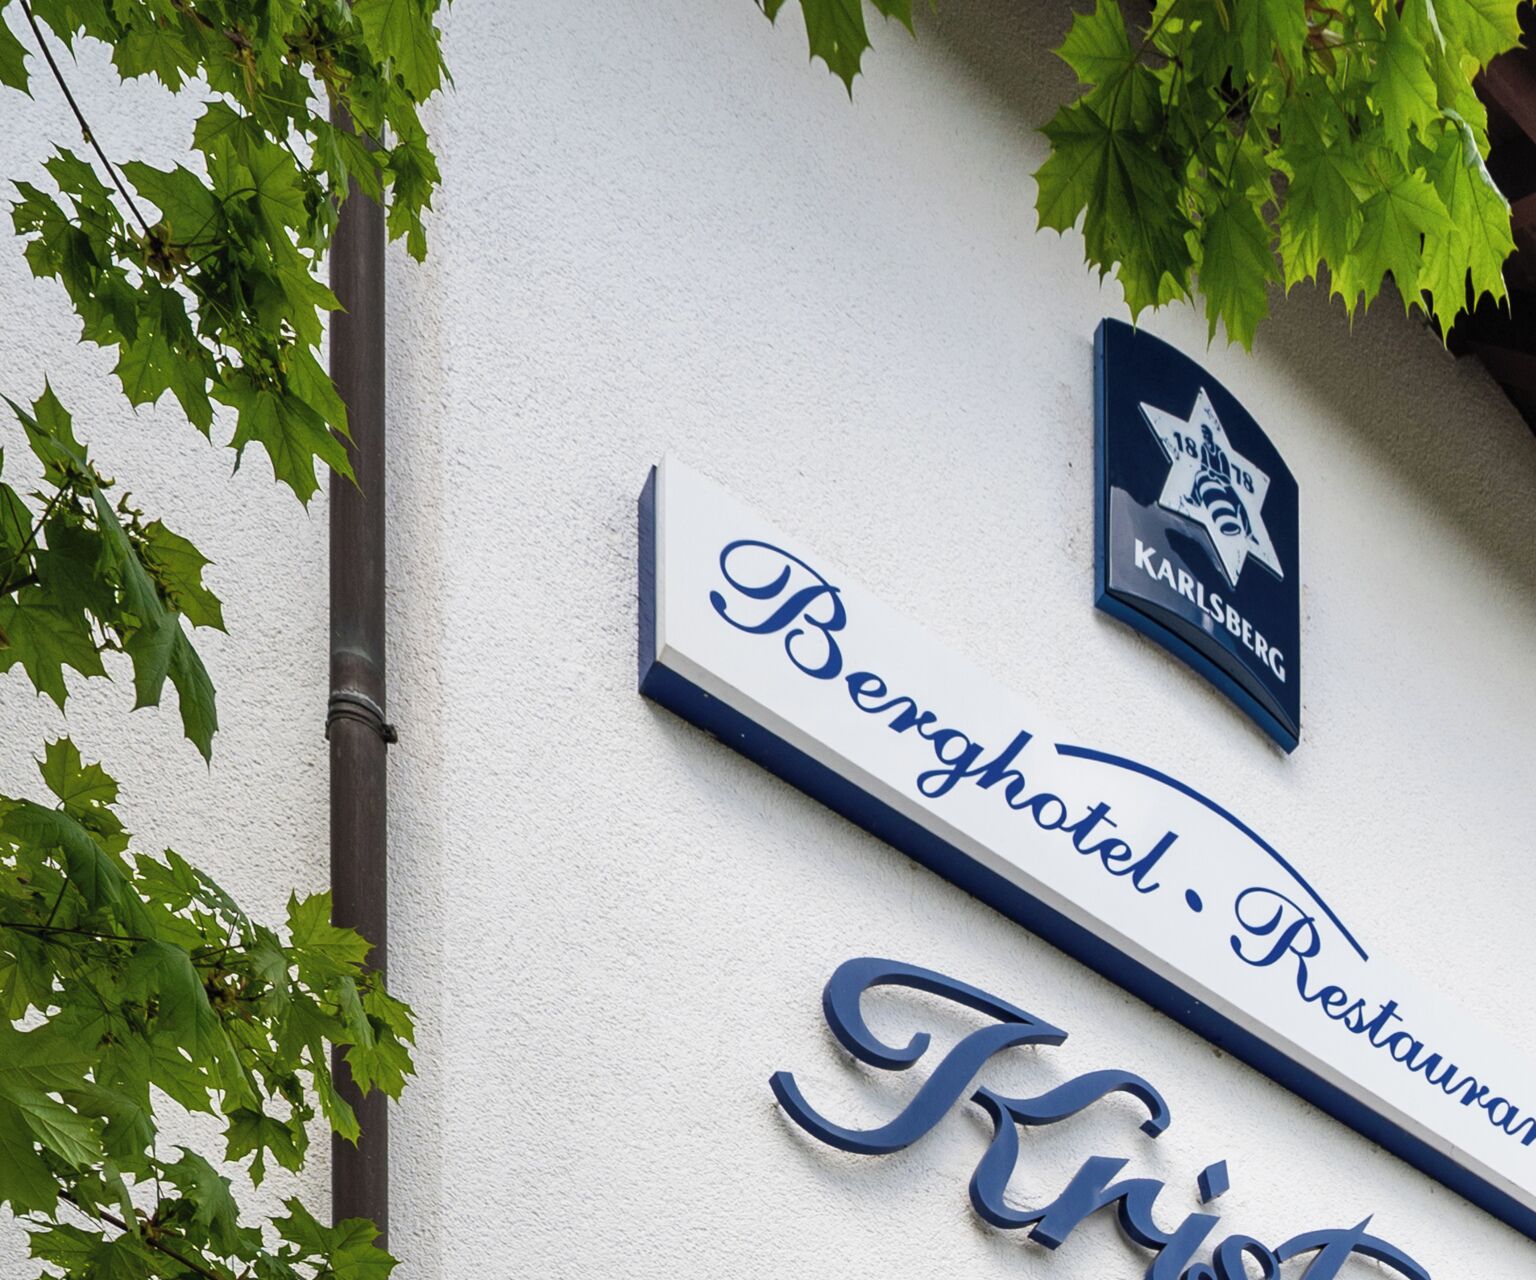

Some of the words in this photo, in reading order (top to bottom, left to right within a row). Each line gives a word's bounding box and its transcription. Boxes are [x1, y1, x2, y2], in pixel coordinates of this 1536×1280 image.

[1173, 431, 1198, 459] 18
[1231, 463, 1255, 494] 78
[1134, 538, 1286, 683] KARLSBERG
[709, 539, 1179, 893] Berghotel
